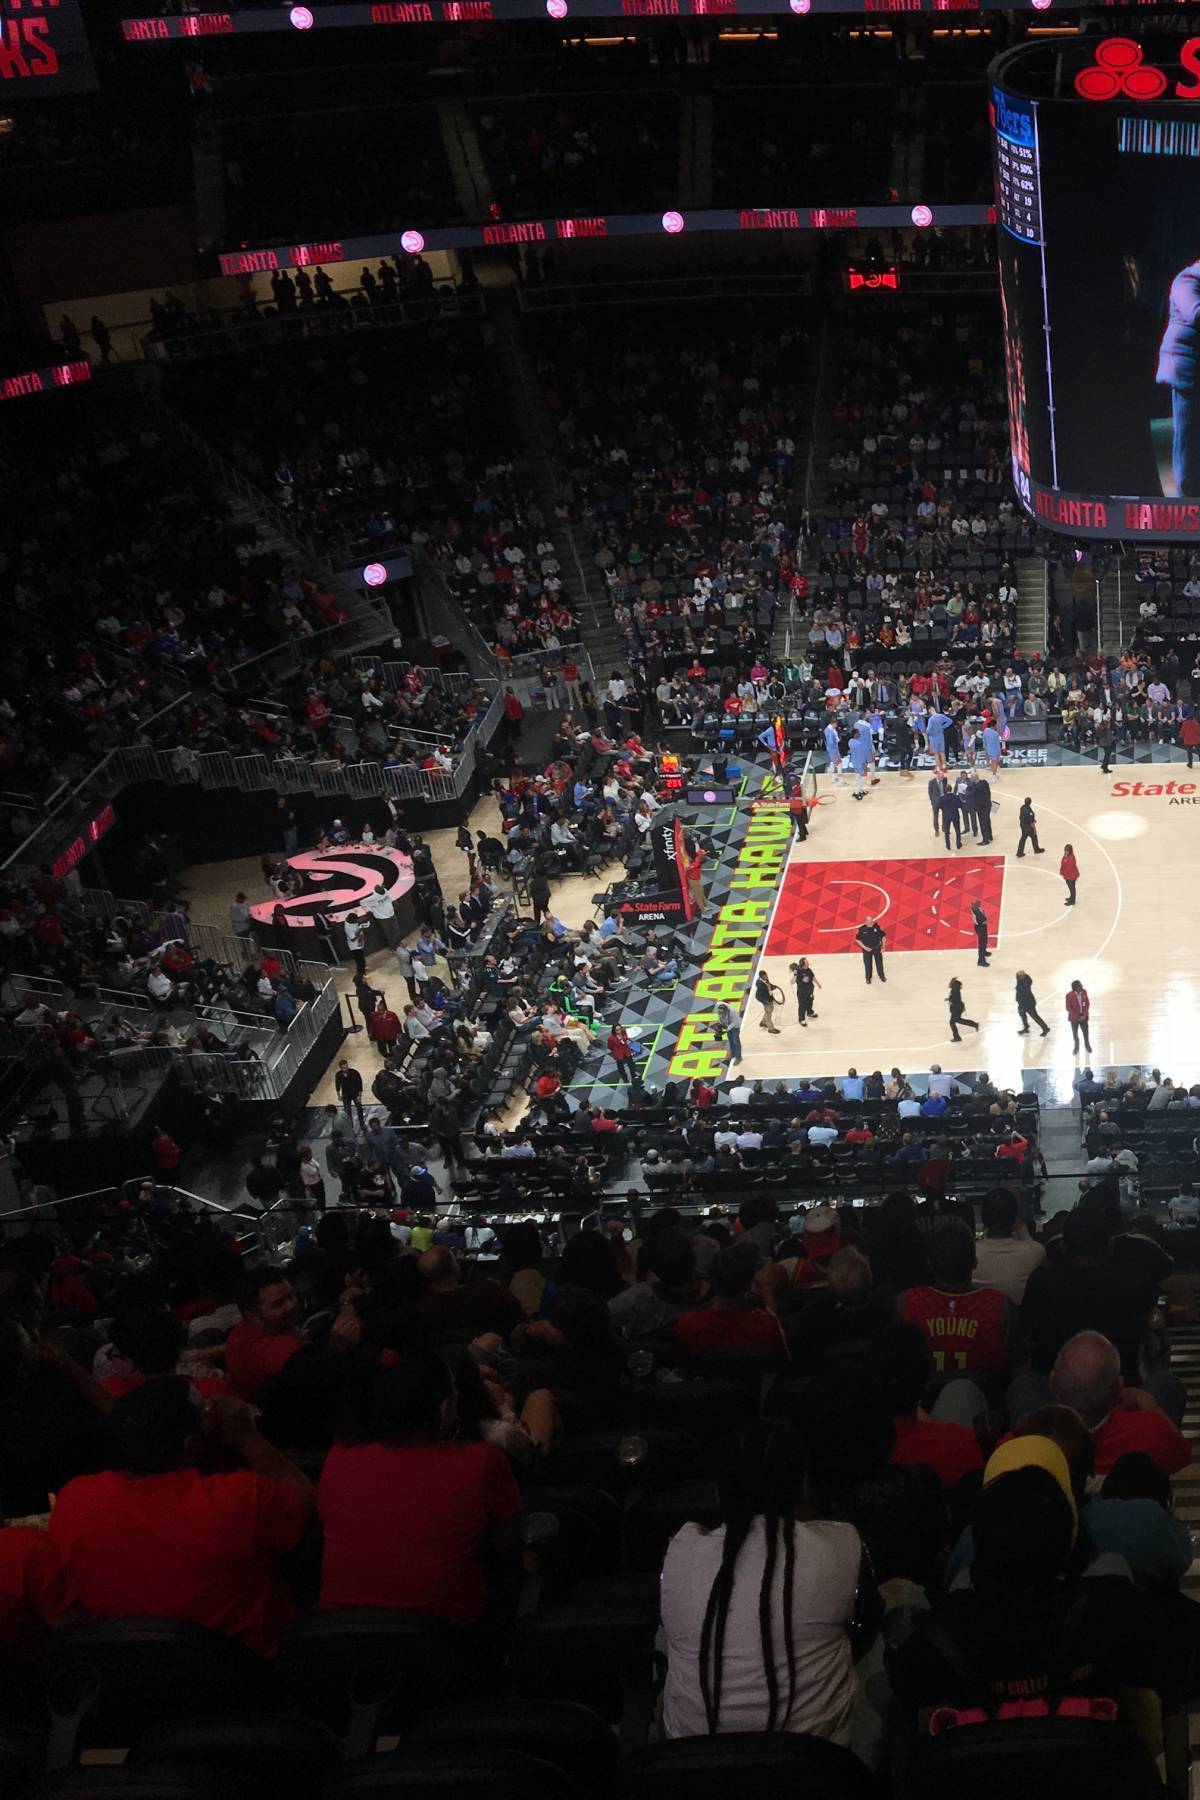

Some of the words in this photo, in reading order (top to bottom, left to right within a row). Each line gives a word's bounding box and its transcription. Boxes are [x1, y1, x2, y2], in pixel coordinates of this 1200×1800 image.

[1035, 490, 1107, 529] ATLANTA
[1125, 503, 1200, 531] HAWKS
[661, 826, 678, 860] xfinity
[639, 912, 665, 921] ARENA
[926, 1317, 978, 1338] YOUNG
